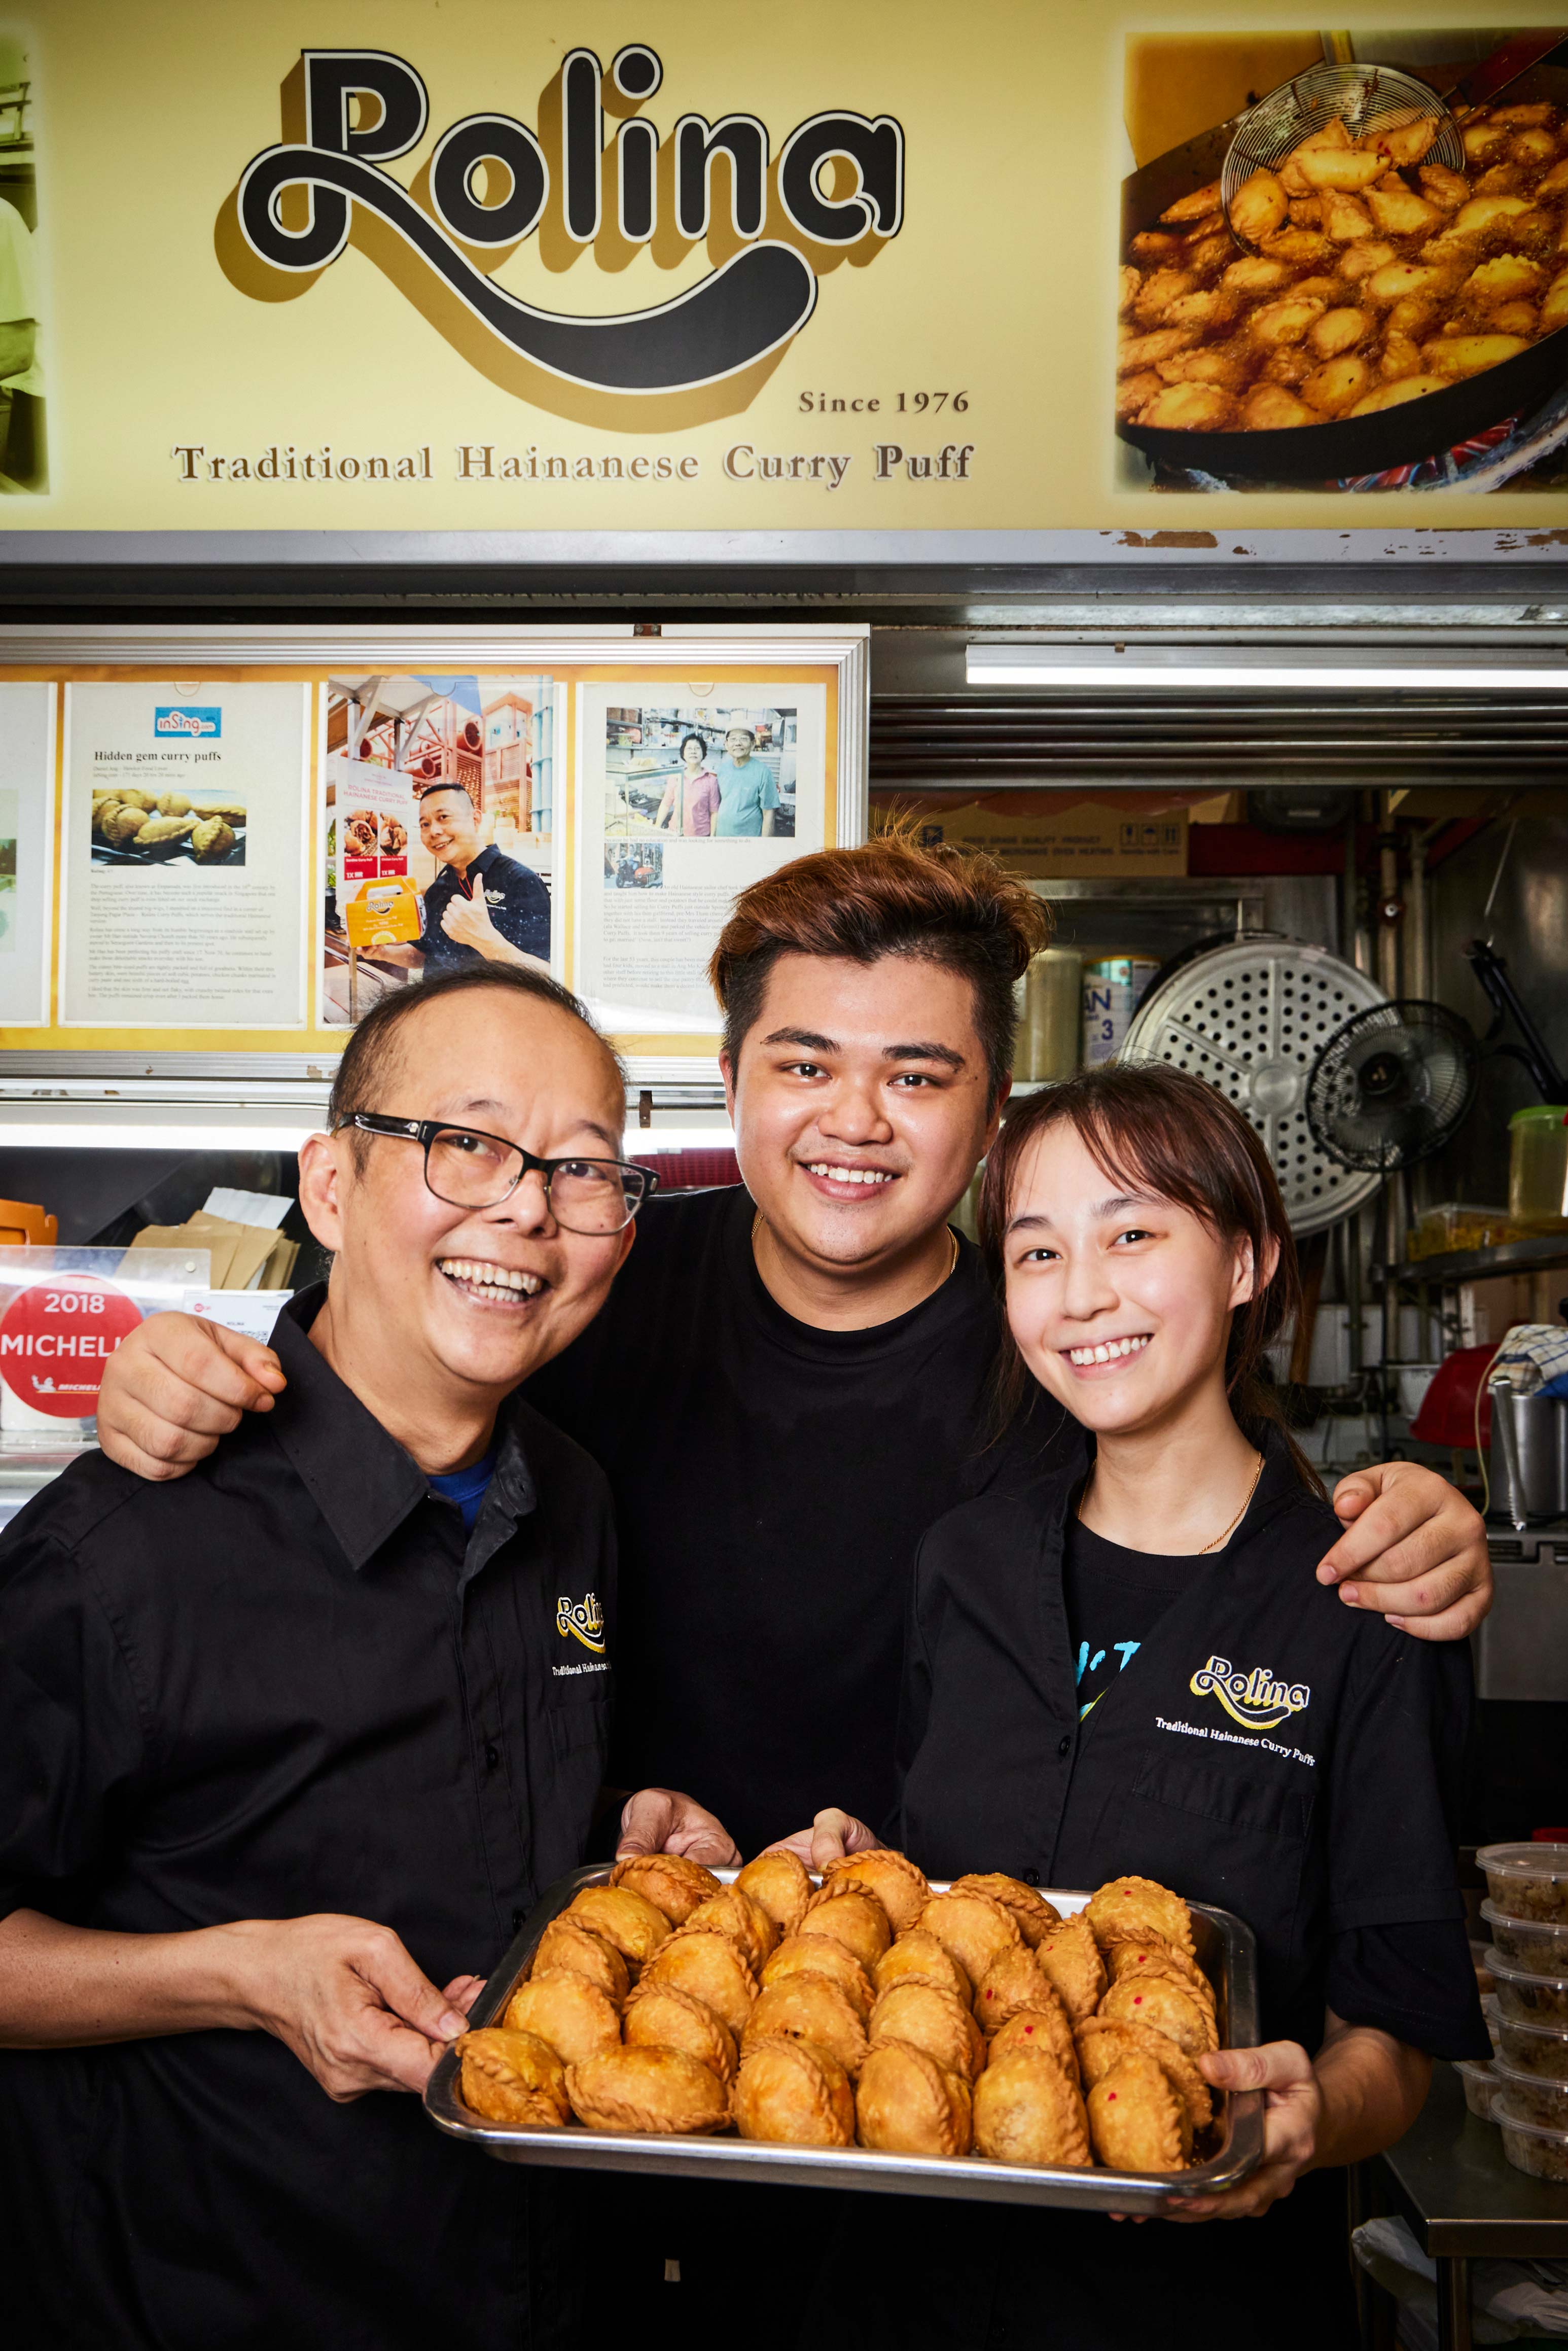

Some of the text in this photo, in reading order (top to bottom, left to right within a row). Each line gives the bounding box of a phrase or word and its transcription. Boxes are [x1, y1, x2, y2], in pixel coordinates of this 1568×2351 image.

[215, 44, 906, 432] Rolina
[799, 391, 969, 413] Since 1976
[174, 445, 974, 488] Traditional Hainanese Curry Puff
[95, 751, 222, 763] Hidden gem curry puffs
[1101, 1019, 1113, 1040] 3
[44, 1293, 105, 1314] 2018
[1, 1334, 122, 1357] MICHELI
[557, 1593, 606, 1654] Roli
[552, 1665, 582, 1675] Traditional
[1190, 1656, 1310, 1730] Rolina
[1156, 1717, 1315, 1766] Traditional Hainanese Curry Puffs
